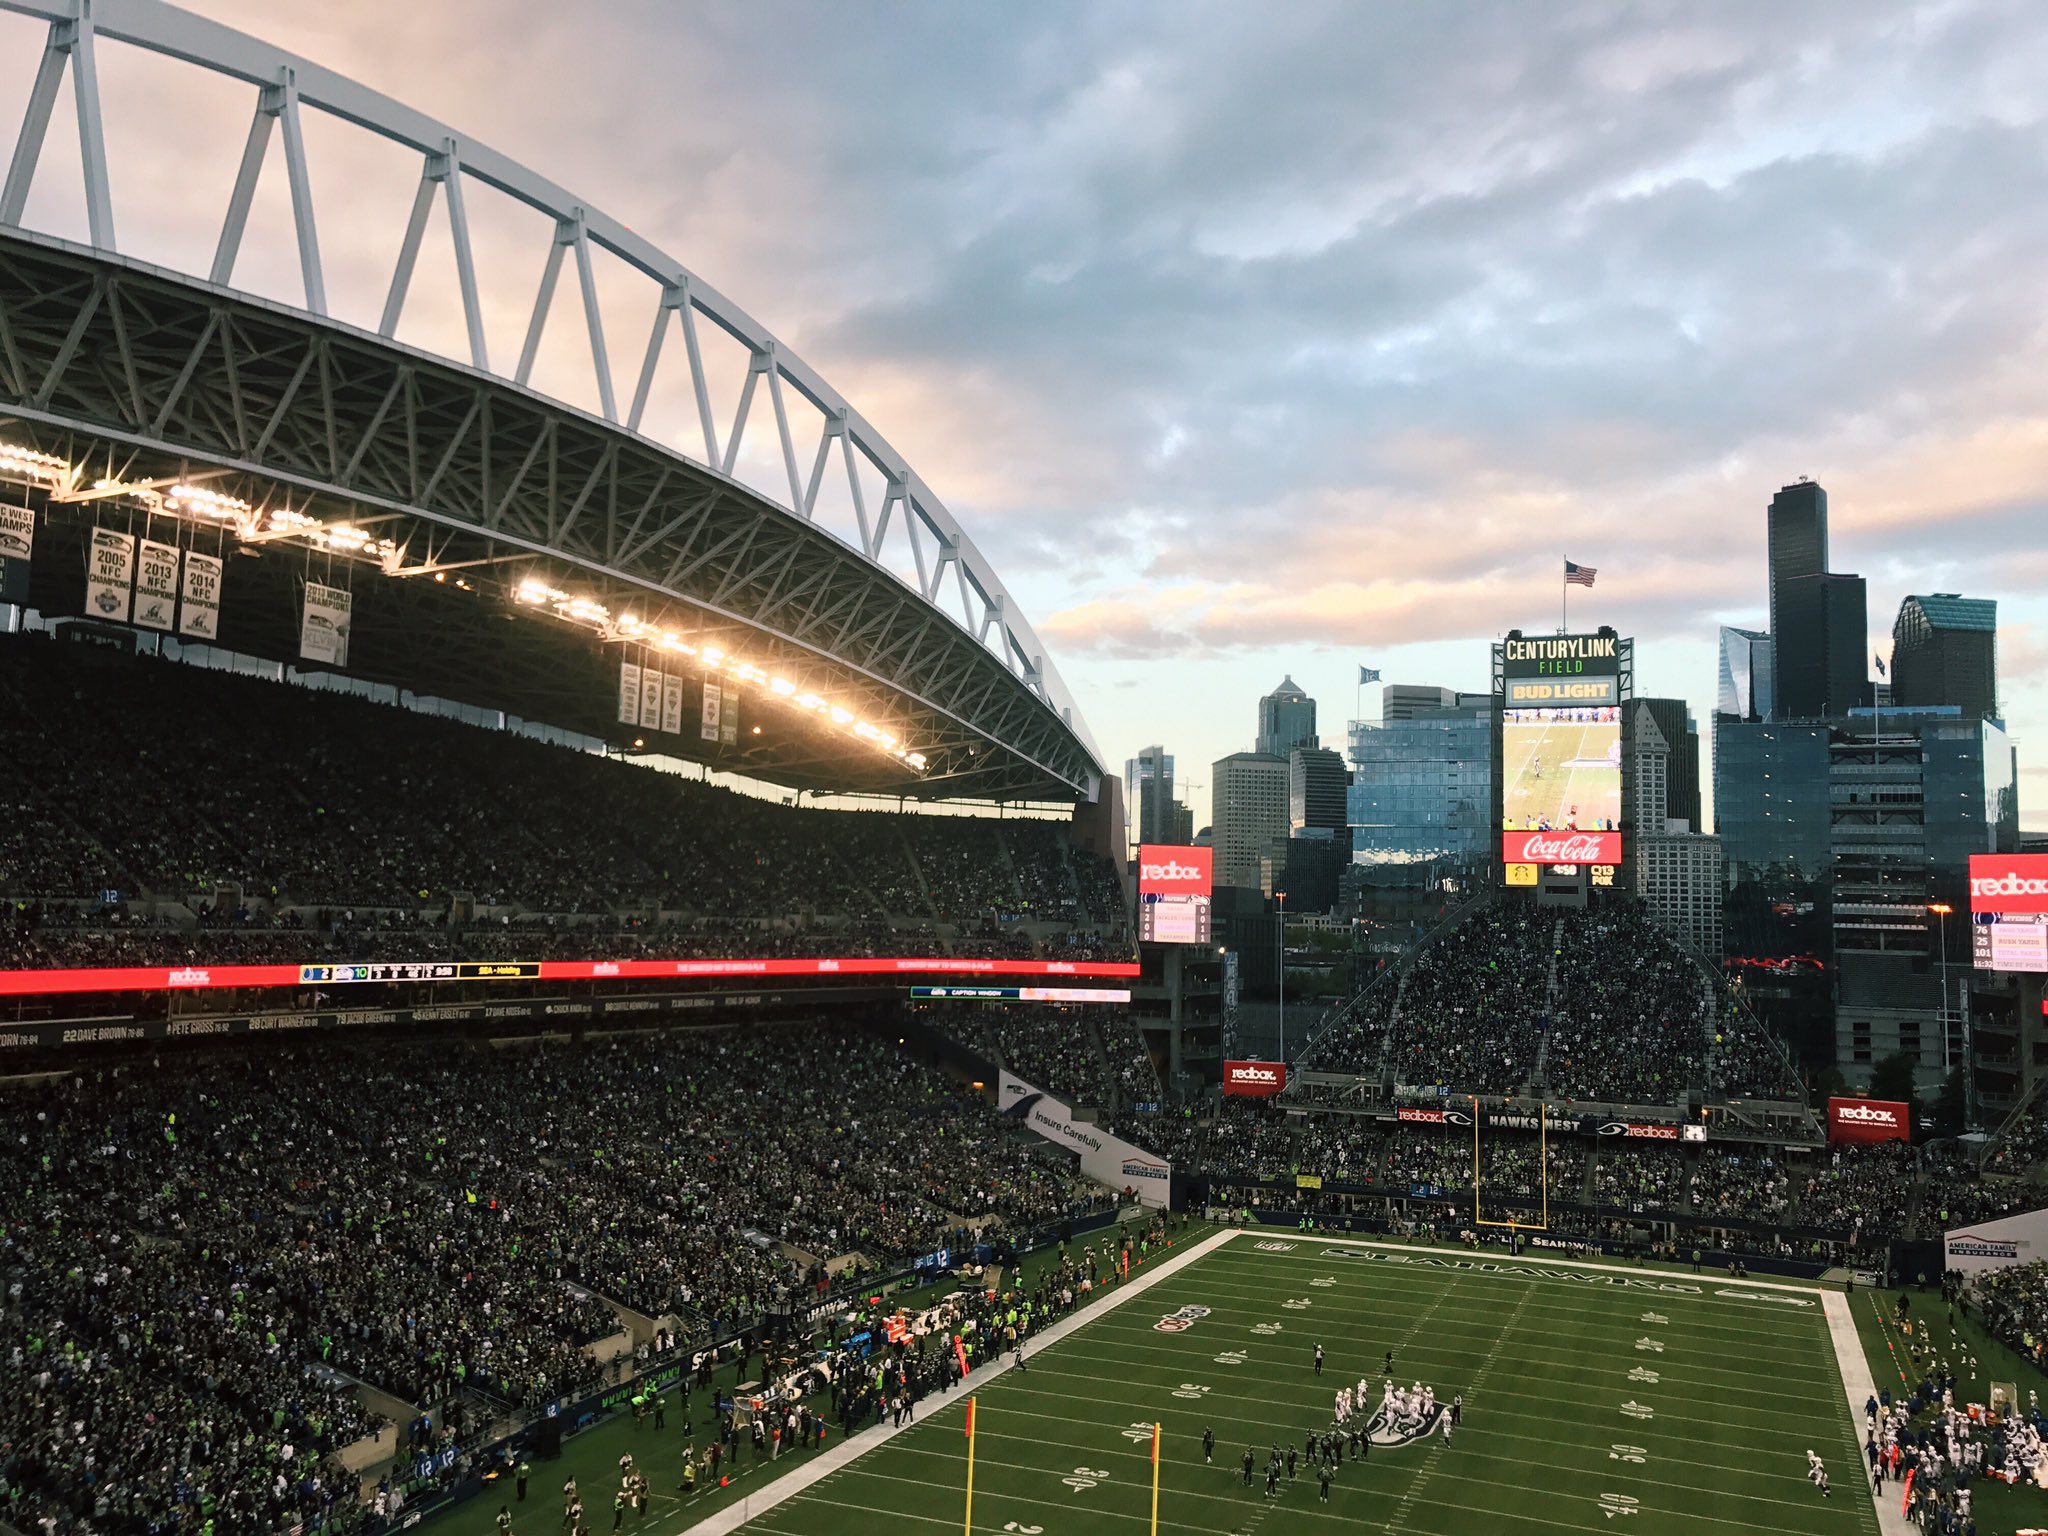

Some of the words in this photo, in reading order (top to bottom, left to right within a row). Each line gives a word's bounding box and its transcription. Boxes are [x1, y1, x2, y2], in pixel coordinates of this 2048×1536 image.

[9, 508, 33, 522] WEST
[97, 550, 126, 568] 2005
[100, 564, 121, 578] NFC
[144, 562, 172, 579] 2013
[89, 574, 130, 590] CHAMPIONS
[147, 576, 167, 589] NFC
[190, 573, 215, 589] 2014
[136, 586, 175, 601] CHAMPIONS
[192, 587, 211, 599] NFC
[307, 585, 325, 597] 2013
[183, 595, 218, 610] CHAMPIONS
[306, 594, 350, 612] CHAMPIONS
[1506, 638, 1616, 660] CENTURYLINK
[1539, 661, 1584, 674] FIELD
[1513, 685, 1553, 699] BUD
[1554, 683, 1609, 698] LIGHT
[1523, 834, 1605, 861] Coca-Cola
[1591, 865, 1615, 876] Q13
[1592, 876, 1613, 886] FOX
[105, 889, 118, 903] 12
[1976, 926, 1988, 934] 76
[1976, 937, 1988, 946] 25
[1975, 949, 1991, 957] 101
[1974, 960, 1993, 968] 11:32
[321, 968, 329, 979] 2
[355, 967, 367, 978] 10
[172, 1021, 189, 1035] PETE
[191, 1021, 213, 1034] GROSS
[261, 1018, 277, 1029] CURT
[63, 1030, 77, 1042] 22
[77, 1029, 97, 1041] DAVE
[99, 1027, 127, 1039] BROWN
[1438, 1086, 1448, 1096] 12
[1148, 1103, 1158, 1112] 12
[1489, 1115, 1538, 1129] HAWKS
[1544, 1118, 1580, 1132] NEST
[1035, 1111, 1062, 1131] Insure
[1063, 1125, 1102, 1152] Carefully
[1430, 1186, 1438, 1194] 12
[1633, 1204, 1643, 1213] 12
[926, 1254, 934, 1266] 12
[937, 1250, 947, 1267] 12
[547, 1405, 557, 1418] 12
[442, 1450, 455, 1467] 12
[420, 1460, 432, 1476] 12
[1062, 1466, 1110, 1488] 30
